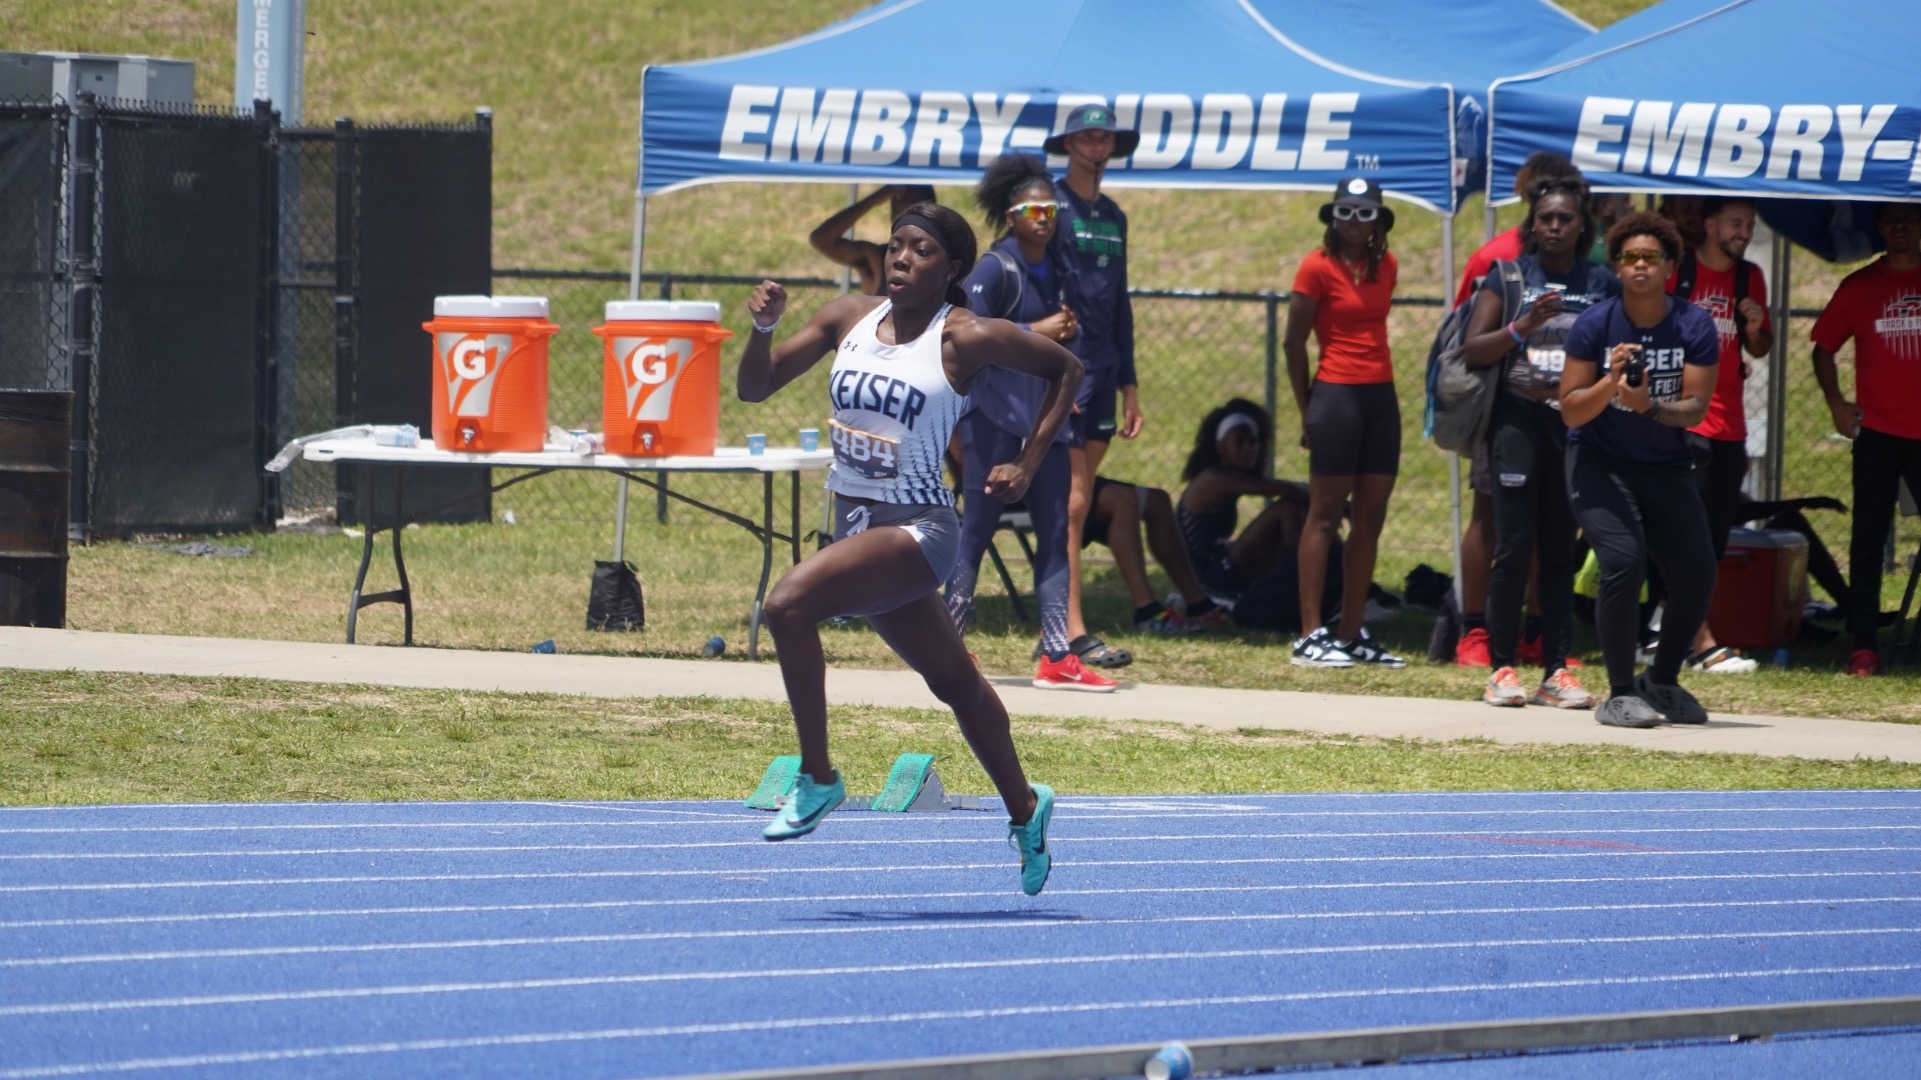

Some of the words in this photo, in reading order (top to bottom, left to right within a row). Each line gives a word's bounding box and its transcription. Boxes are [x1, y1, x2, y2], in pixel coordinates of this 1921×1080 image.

[1571, 96, 1921, 182] EMBRY-
[453, 339, 486, 380] G
[632, 344, 667, 384] G
[832, 425, 895, 468] 484
